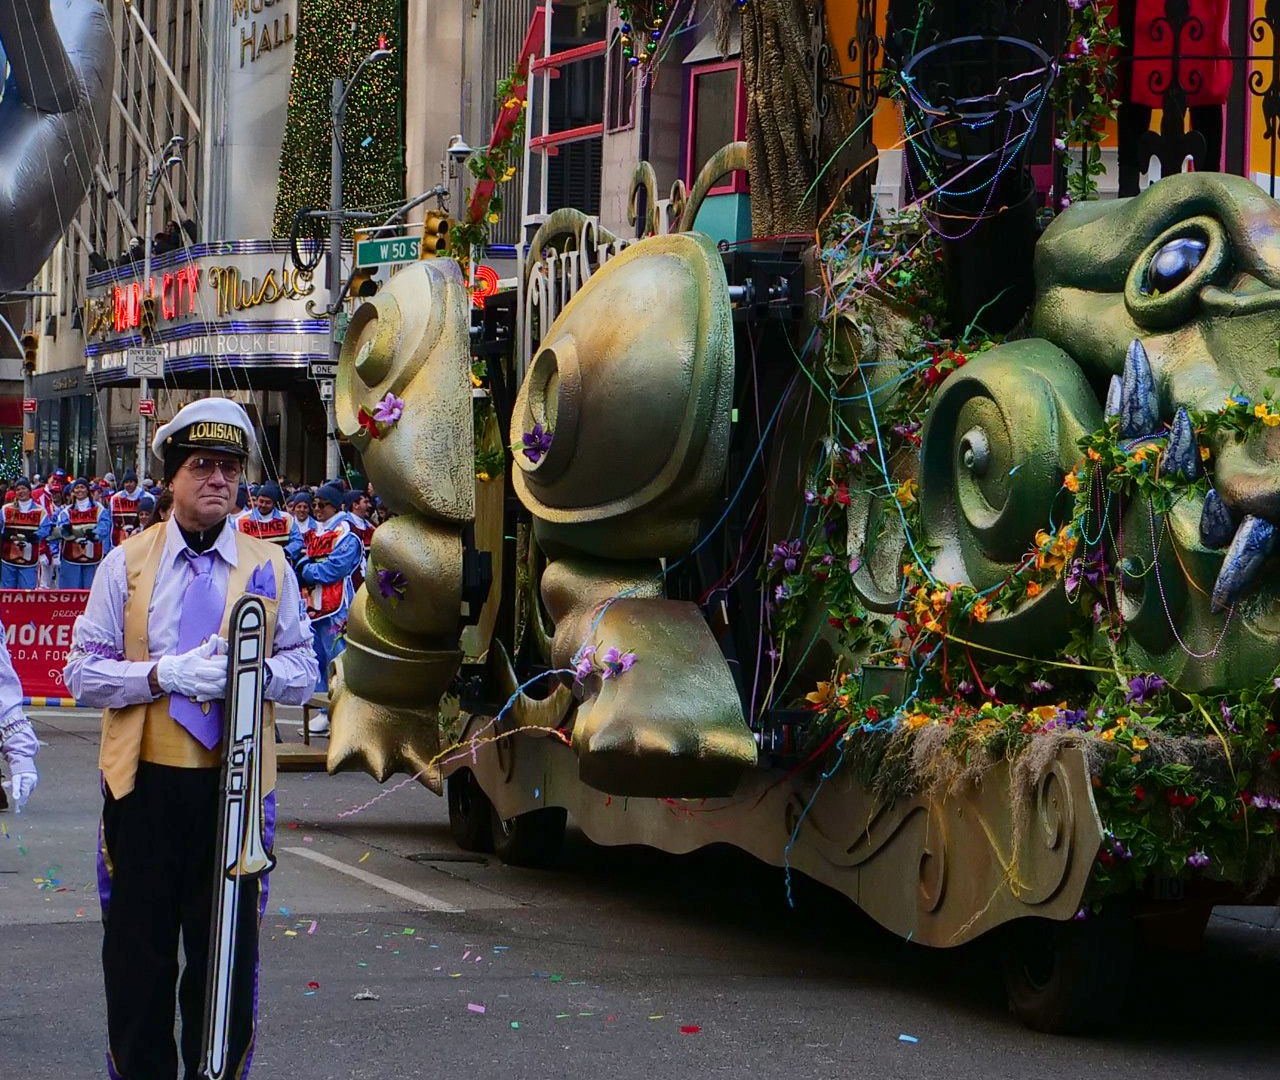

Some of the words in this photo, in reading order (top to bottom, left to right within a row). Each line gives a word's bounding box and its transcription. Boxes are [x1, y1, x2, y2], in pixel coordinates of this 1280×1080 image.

[240, 13, 294, 69] HALL
[380, 245, 389, 260] W
[392, 244, 406, 258] 50
[208, 265, 314, 317] Music
[317, 366, 332, 374] ONE
[243, 519, 288, 534] SMOKEY
[2, 593, 89, 603] HANKSGIV
[5, 623, 71, 646] MOKE
[45, 650, 68, 661] FOR
